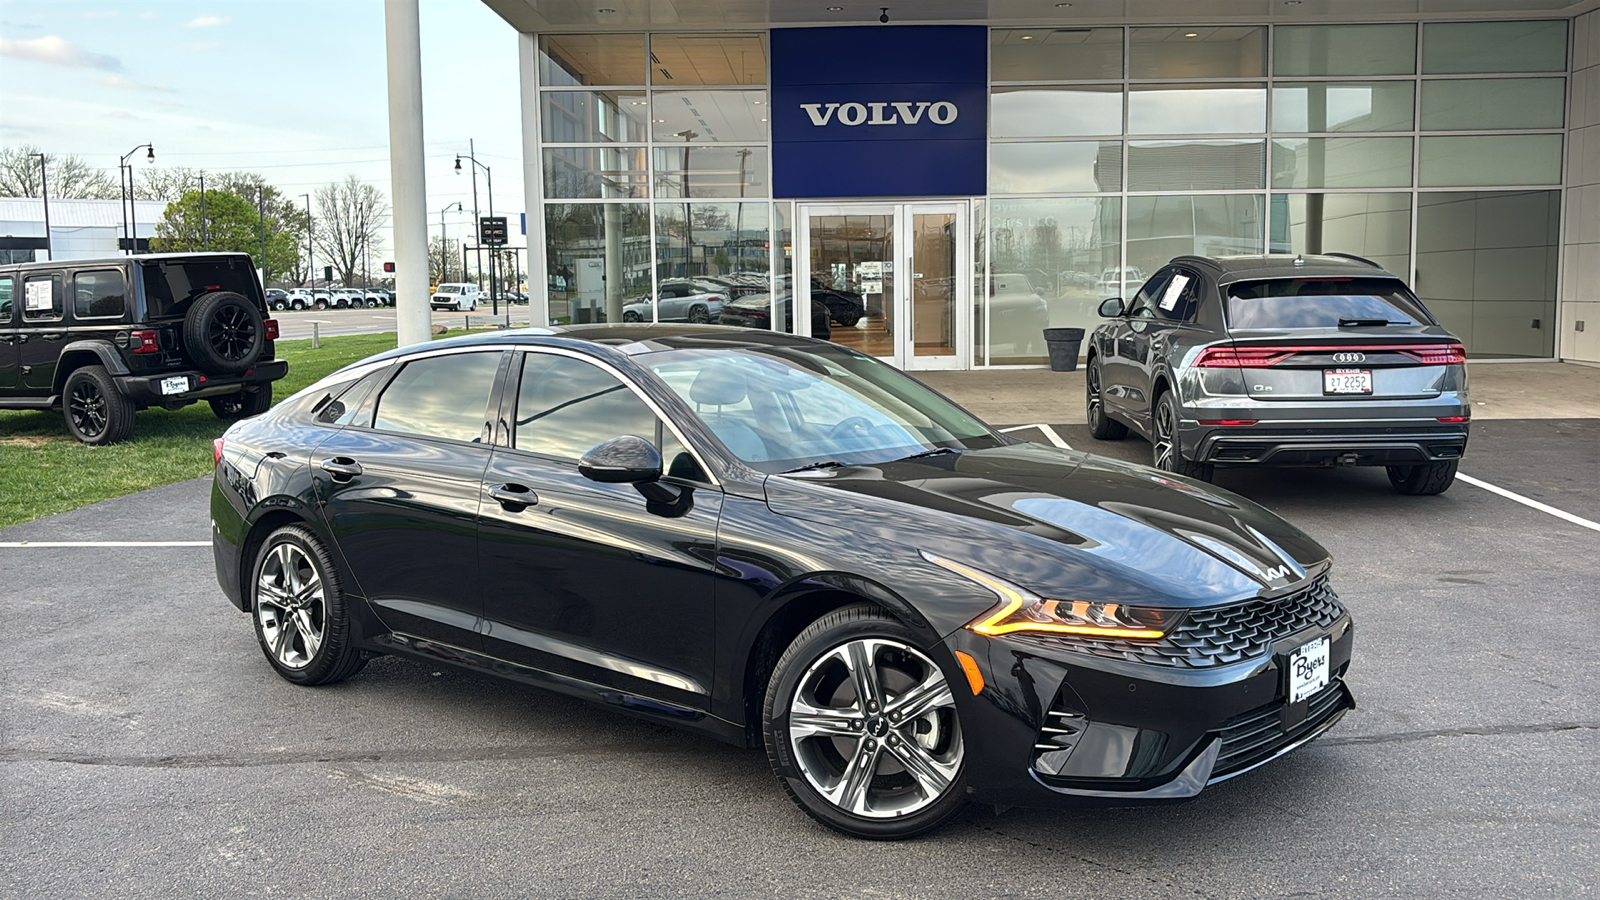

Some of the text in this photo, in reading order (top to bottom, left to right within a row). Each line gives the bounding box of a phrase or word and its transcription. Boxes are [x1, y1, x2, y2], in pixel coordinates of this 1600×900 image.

[800, 101, 958, 126] VOLVO
[1331, 376, 1366, 388] 27 2252
[1292, 655, 1326, 681] Byers
